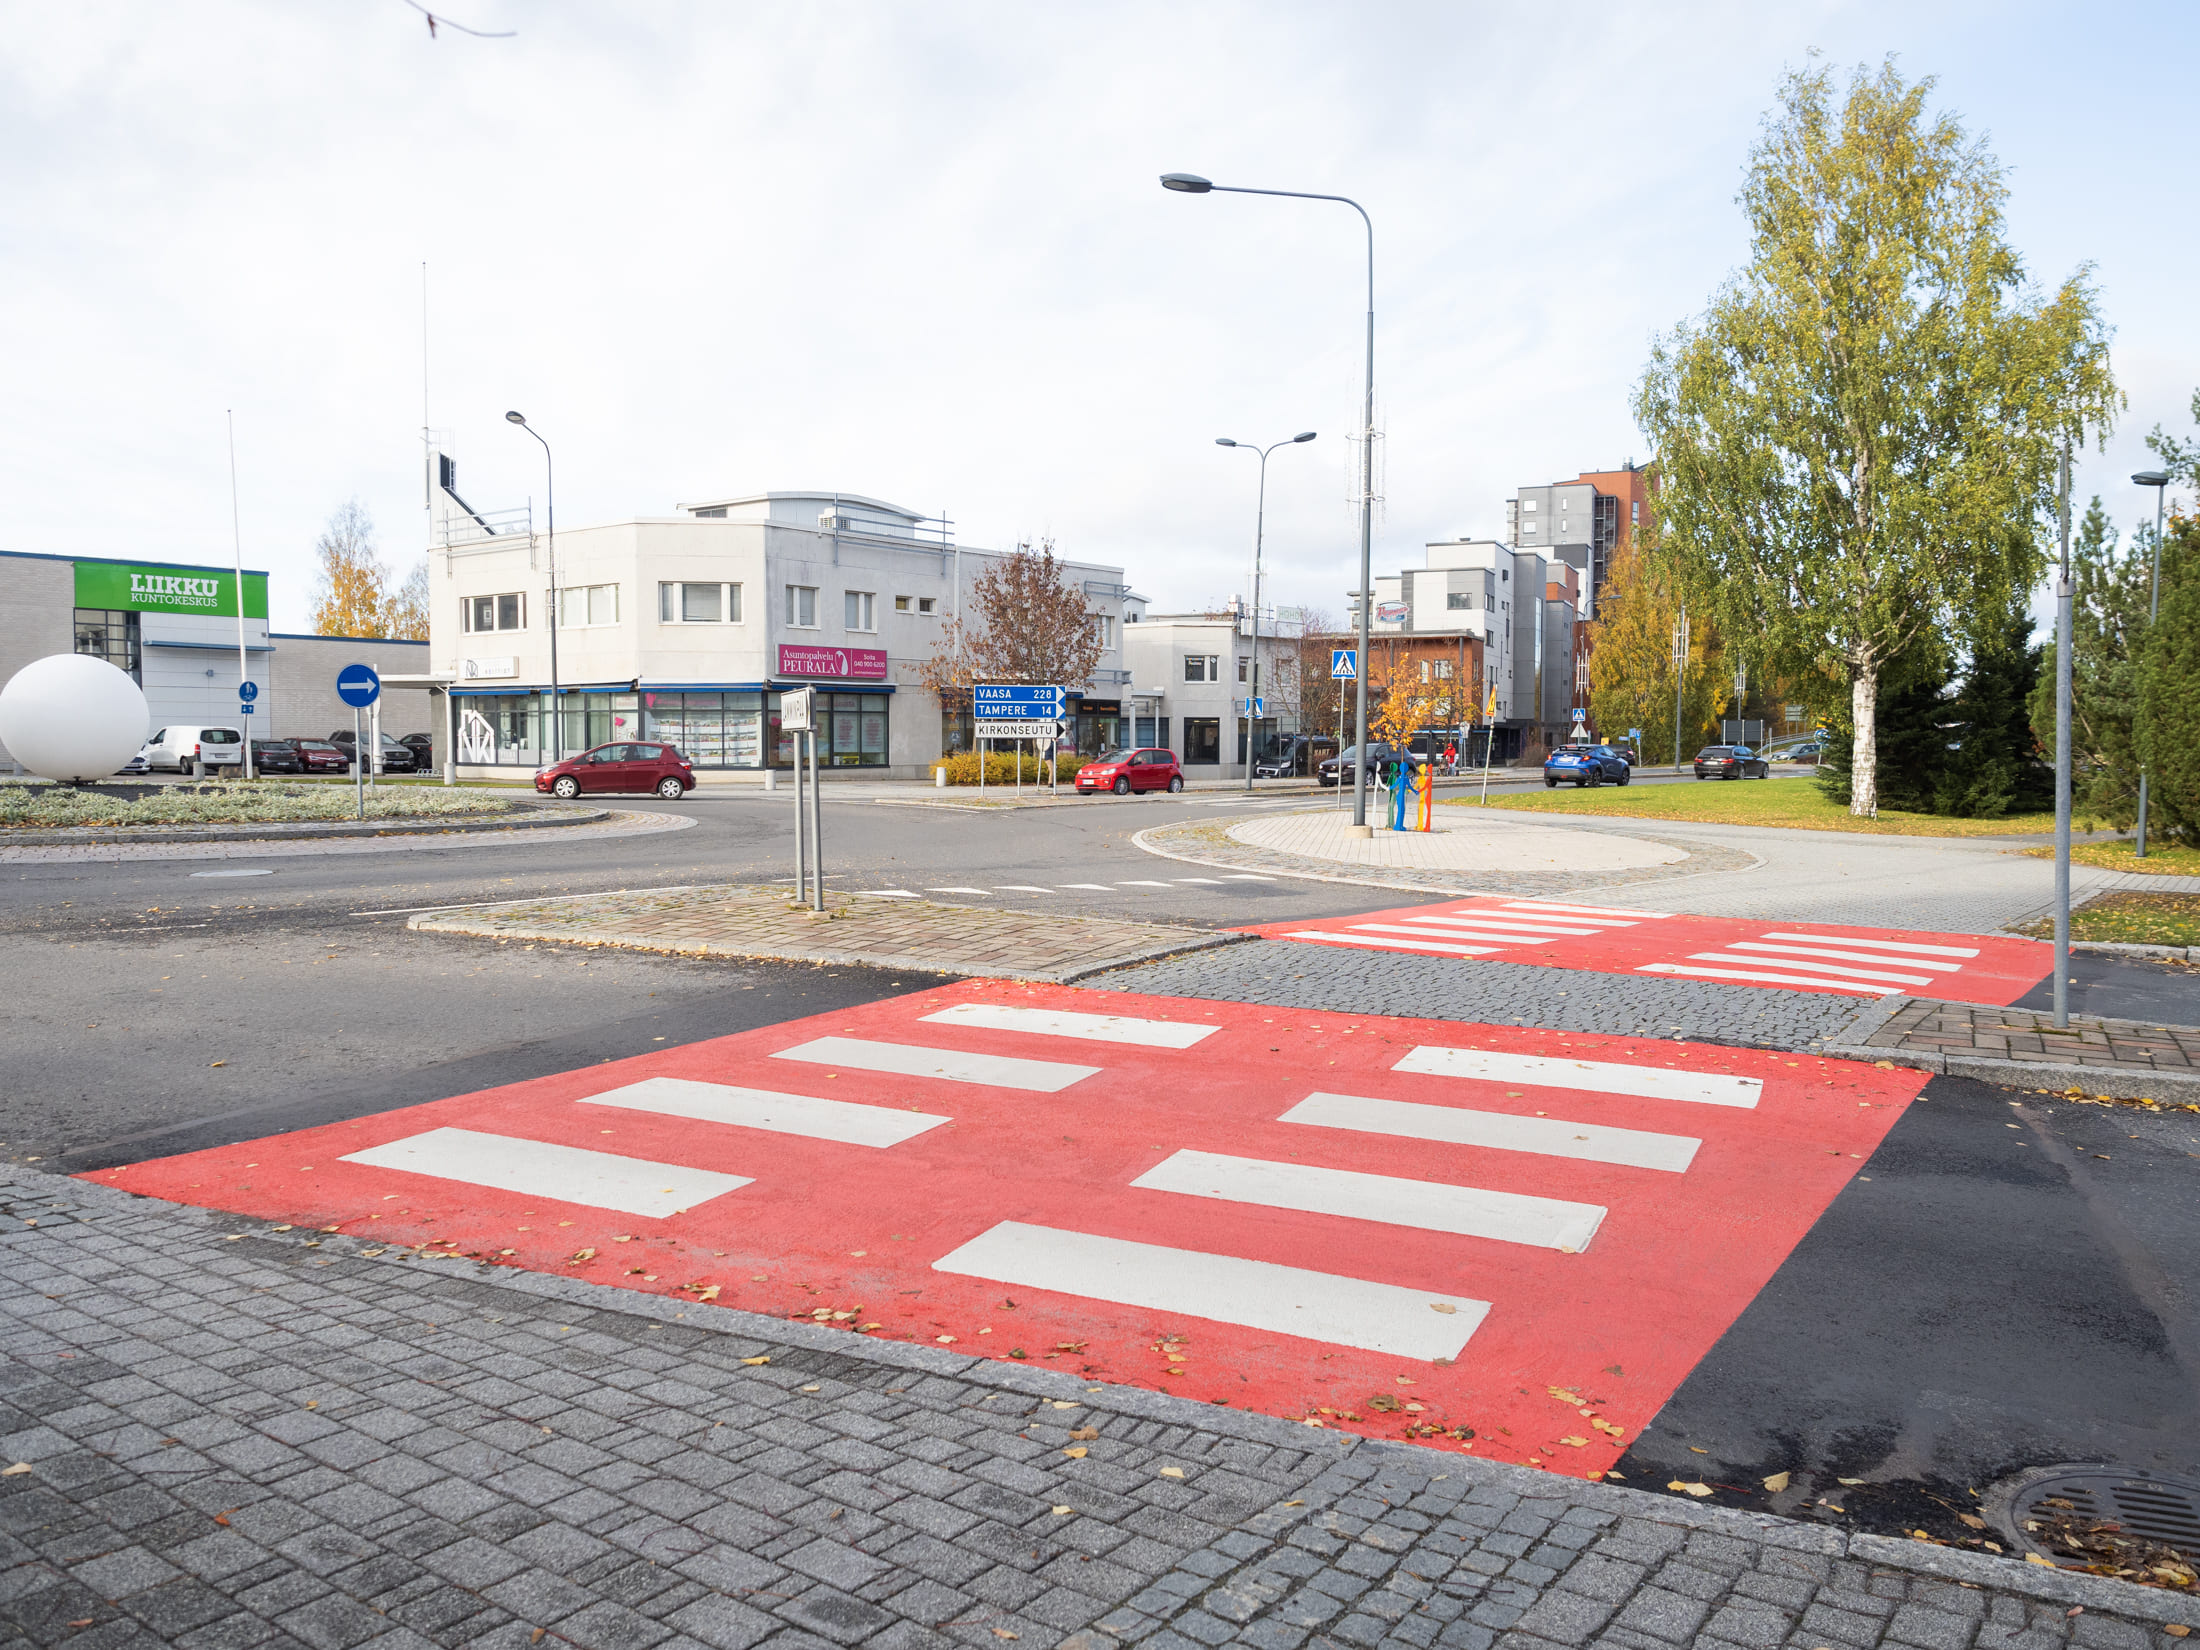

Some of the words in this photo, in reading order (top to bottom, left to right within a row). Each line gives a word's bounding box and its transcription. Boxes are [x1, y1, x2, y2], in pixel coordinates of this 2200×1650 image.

[130, 573, 219, 597] LIIKKU
[131, 592, 218, 607] KUNTOKESKUS
[783, 649, 834, 661] Asuntopalvelu
[783, 660, 837, 674] PEURALA
[979, 689, 1012, 699] VAASA
[1033, 689, 1052, 699] 228
[979, 705, 1028, 715] TAMPERE
[1041, 706, 1052, 715] 14
[978, 725, 1052, 735] KIRKONSEUTU
